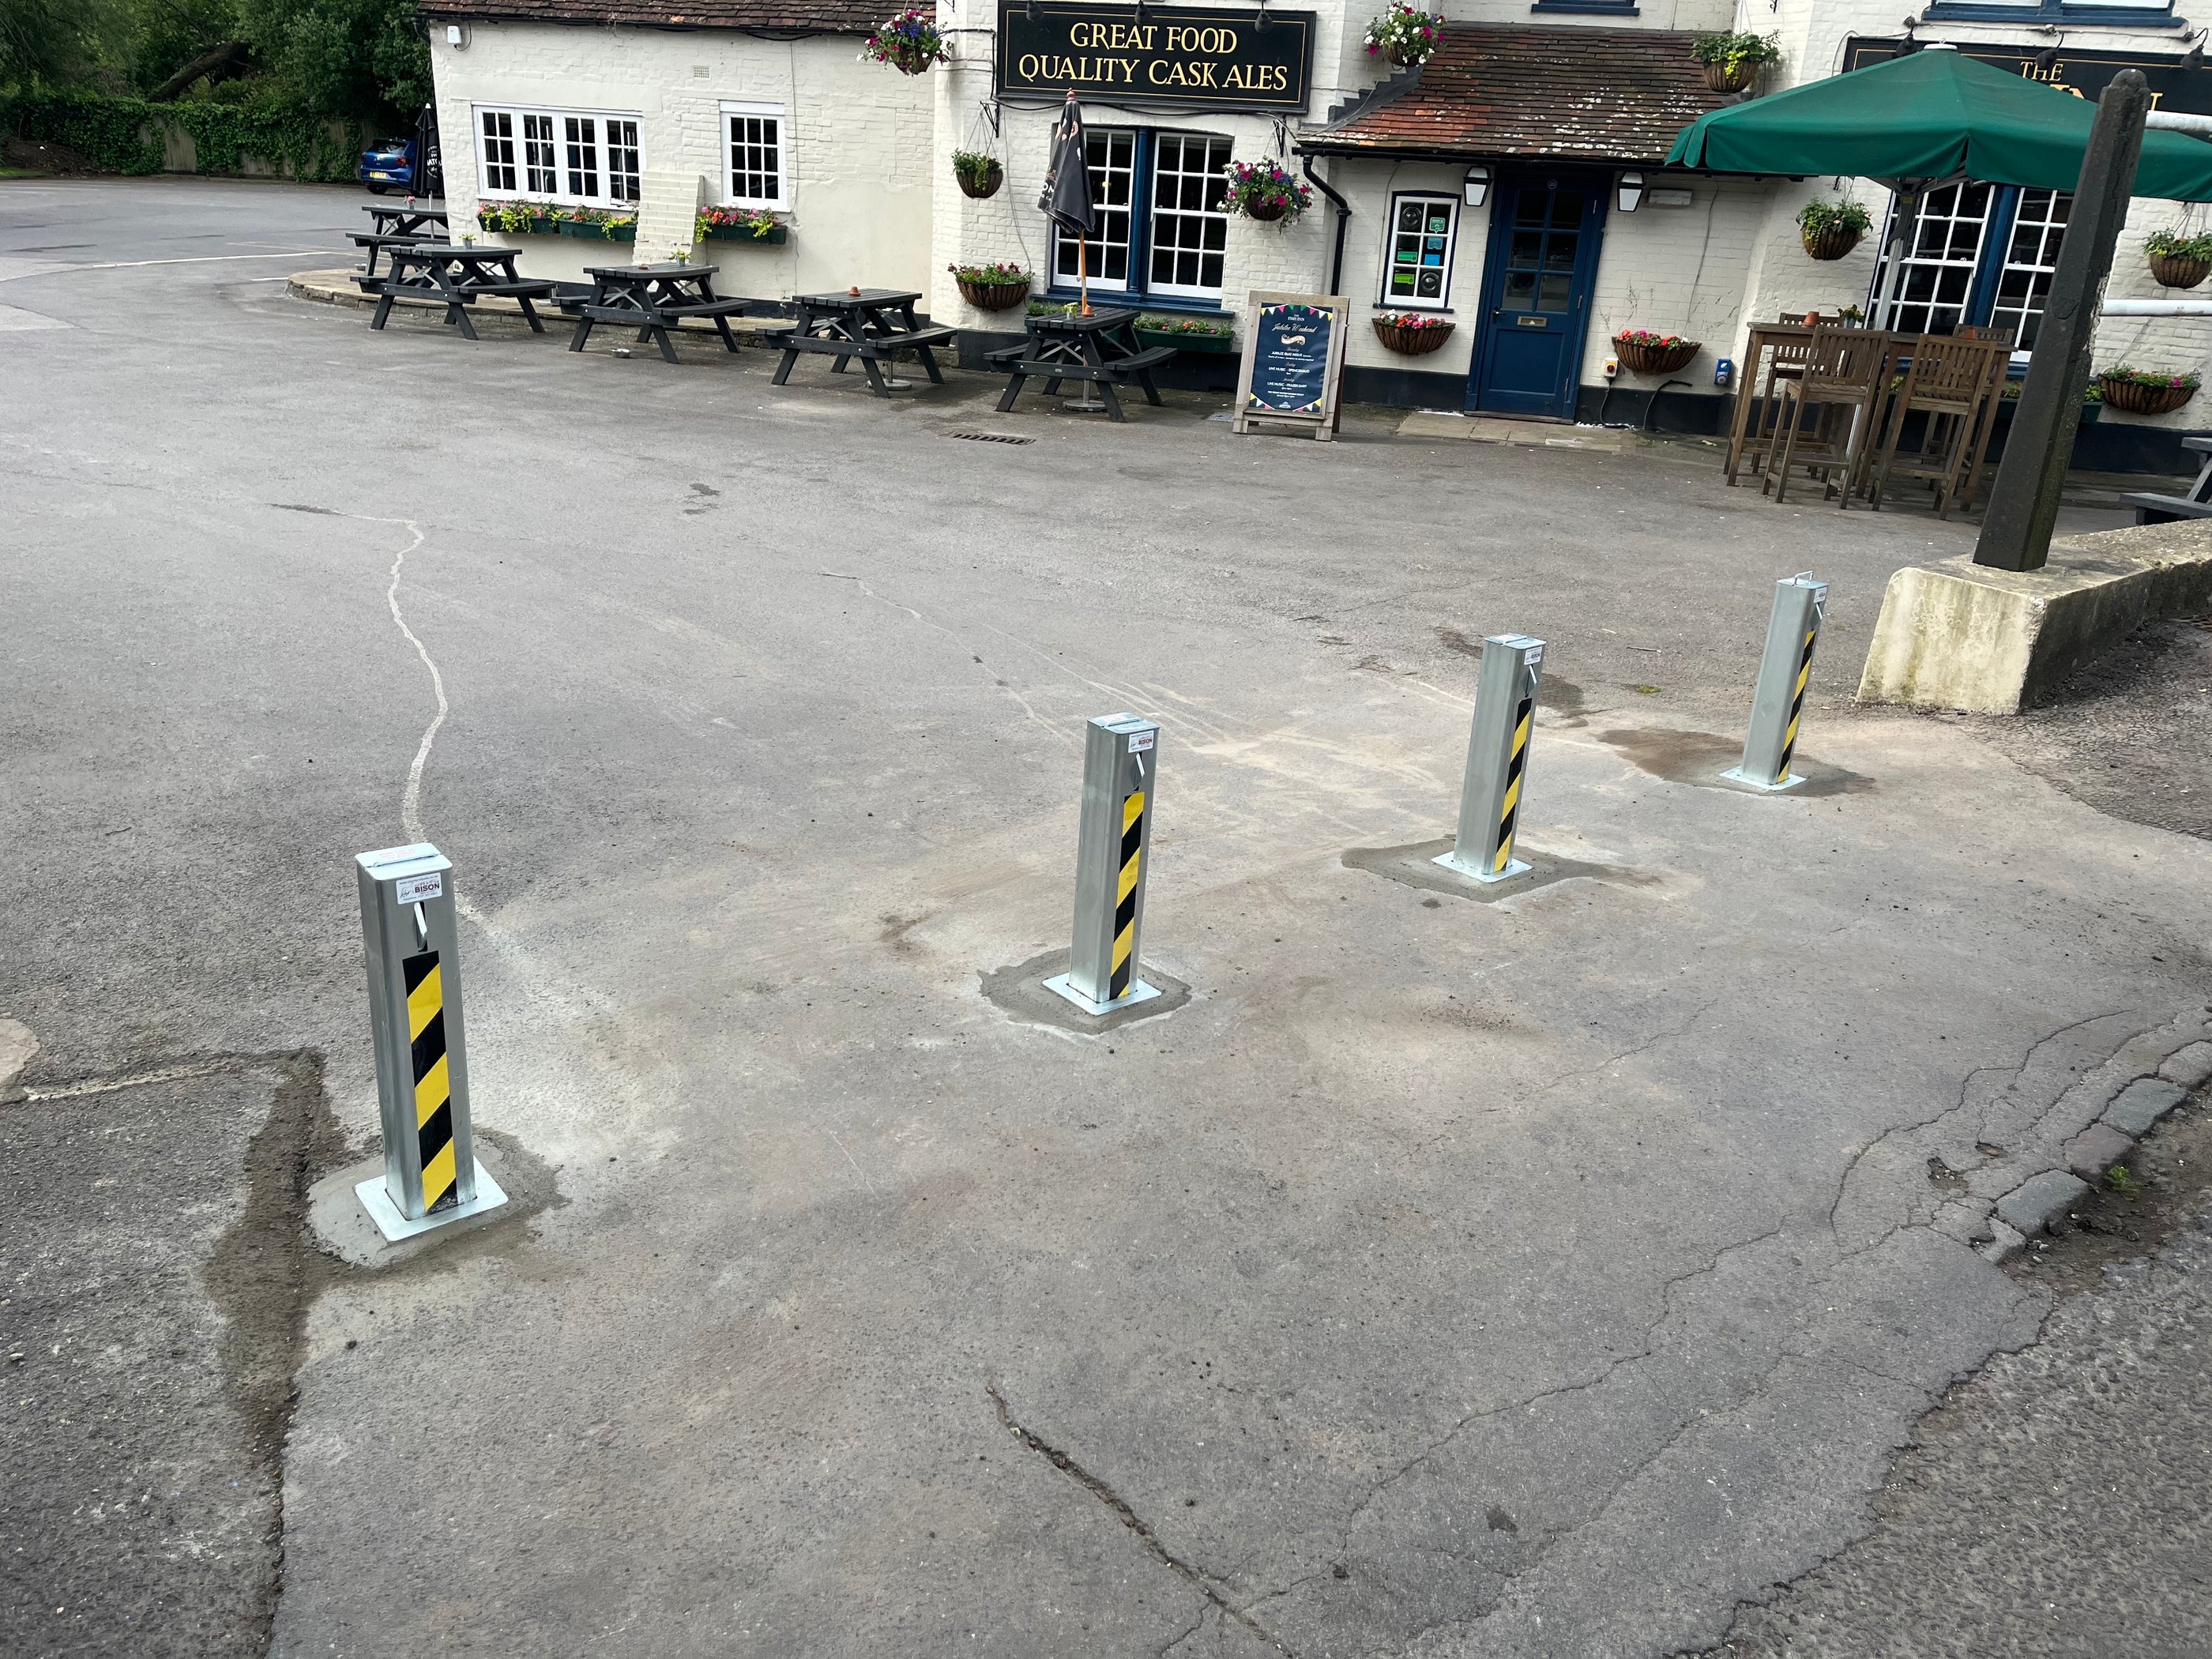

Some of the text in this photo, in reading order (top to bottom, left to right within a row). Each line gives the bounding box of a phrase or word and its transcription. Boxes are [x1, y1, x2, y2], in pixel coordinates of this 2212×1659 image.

[1070, 22, 1238, 55] GREAT FOOD
[1018, 54, 1288, 91] QUALITY CASK ALES
[2020, 61, 2063, 82] THE
[1292, 323, 1317, 333] Weekend
[415, 882, 440, 893] BISON
